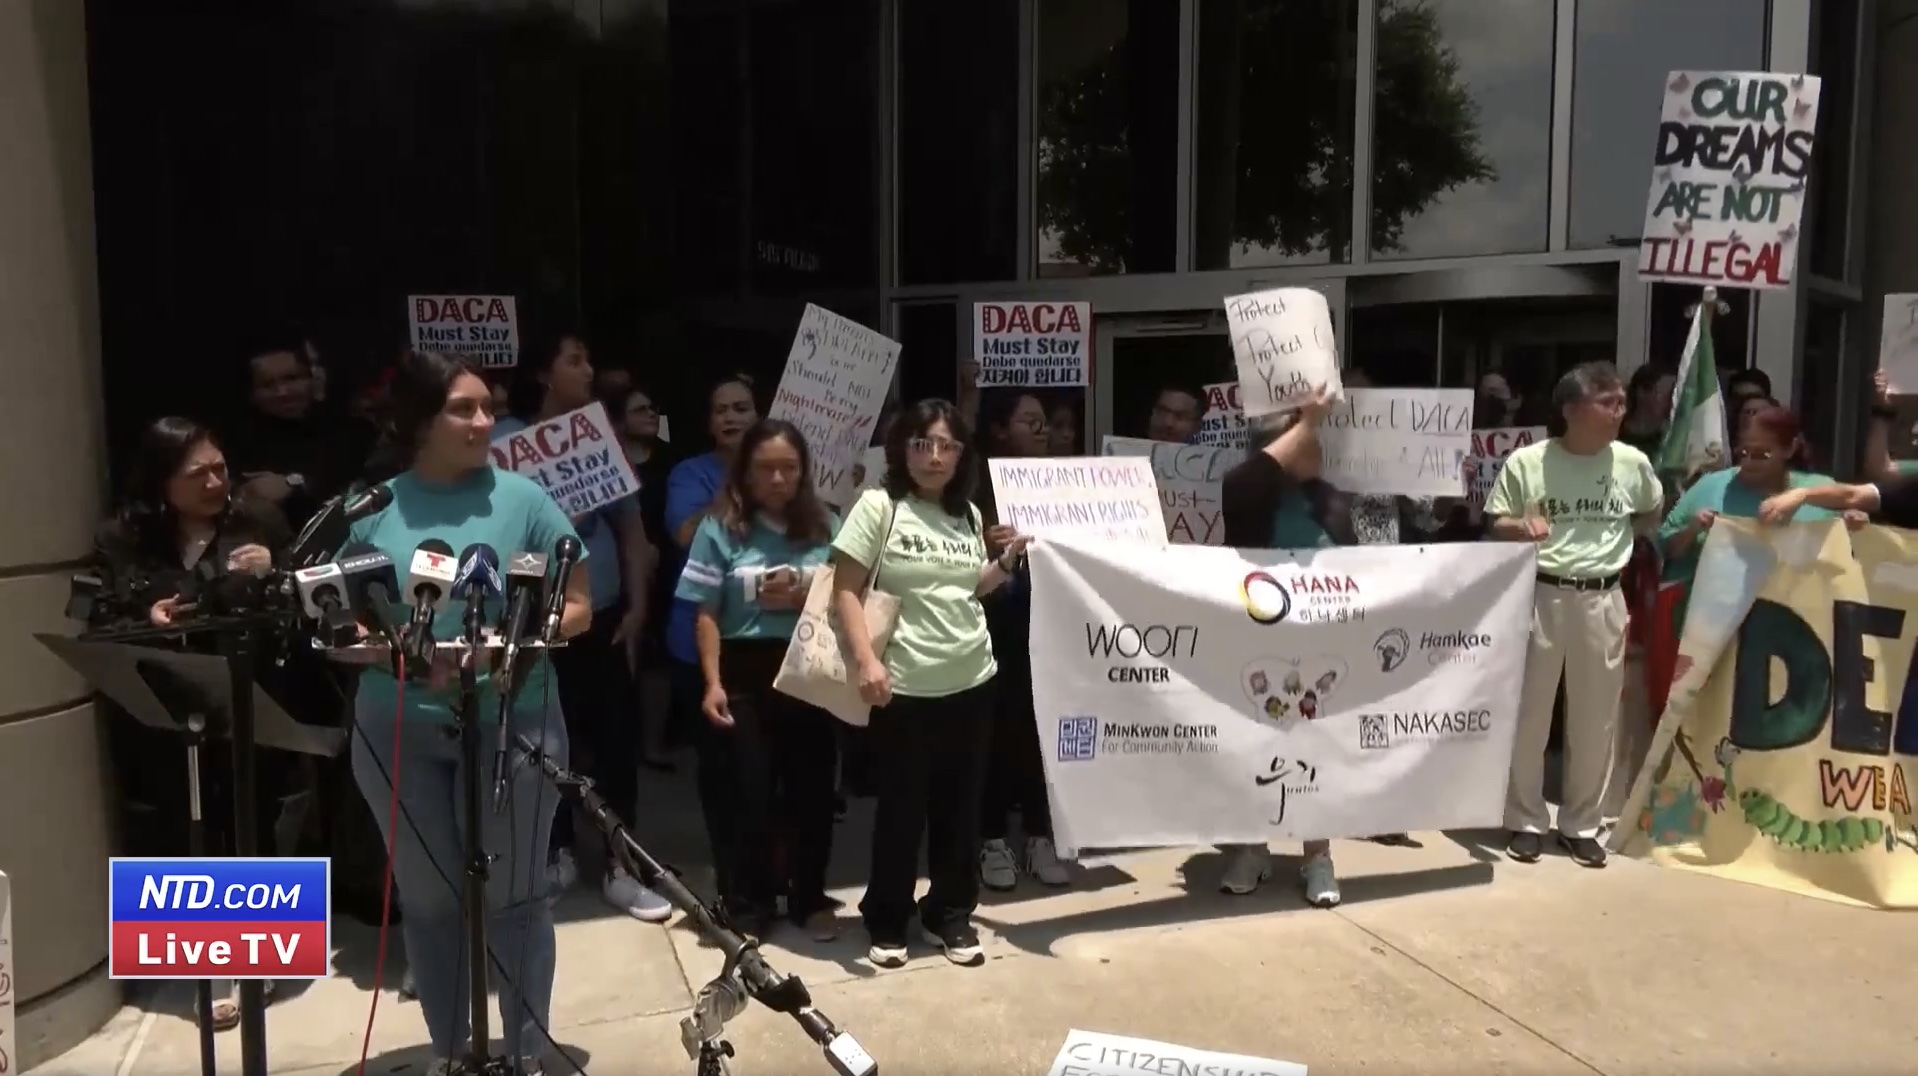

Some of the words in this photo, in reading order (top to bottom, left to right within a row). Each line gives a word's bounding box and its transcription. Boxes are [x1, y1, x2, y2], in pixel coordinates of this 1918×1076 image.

[1691, 78, 1789, 123] OUR
[1654, 121, 1814, 178] DREAMS
[1653, 181, 1718, 220] ARE
[1721, 182, 1806, 223] NOT
[1638, 236, 1790, 286] ILLEGAL
[416, 298, 509, 323] DACA
[982, 304, 1081, 333] DACA
[1229, 297, 1286, 322] Protect
[418, 327, 465, 341] Must
[469, 326, 510, 342] Stay
[982, 338, 1031, 354] Must
[1037, 338, 1079, 355] Stay
[1236, 328, 1303, 363] Protect
[983, 356, 1016, 367] Debe
[1411, 400, 1469, 432] DACA
[1471, 431, 1534, 459] ACA
[555, 445, 609, 481] Stay
[999, 464, 1086, 489] IMMIGRANT
[1163, 490, 1216, 509] UST
[1007, 501, 1096, 530] IMMIGRANT
[1169, 511, 1221, 543] AY
[1290, 575, 1360, 594] HANA
[1419, 630, 1491, 650] Hamkae
[1107, 666, 1170, 683] CENTER
[1729, 597, 1918, 757] DE
[1394, 709, 1491, 735] NAKASEC
[1122, 738, 1183, 755] Community
[1068, 1043, 1281, 1076] CITIZENS
